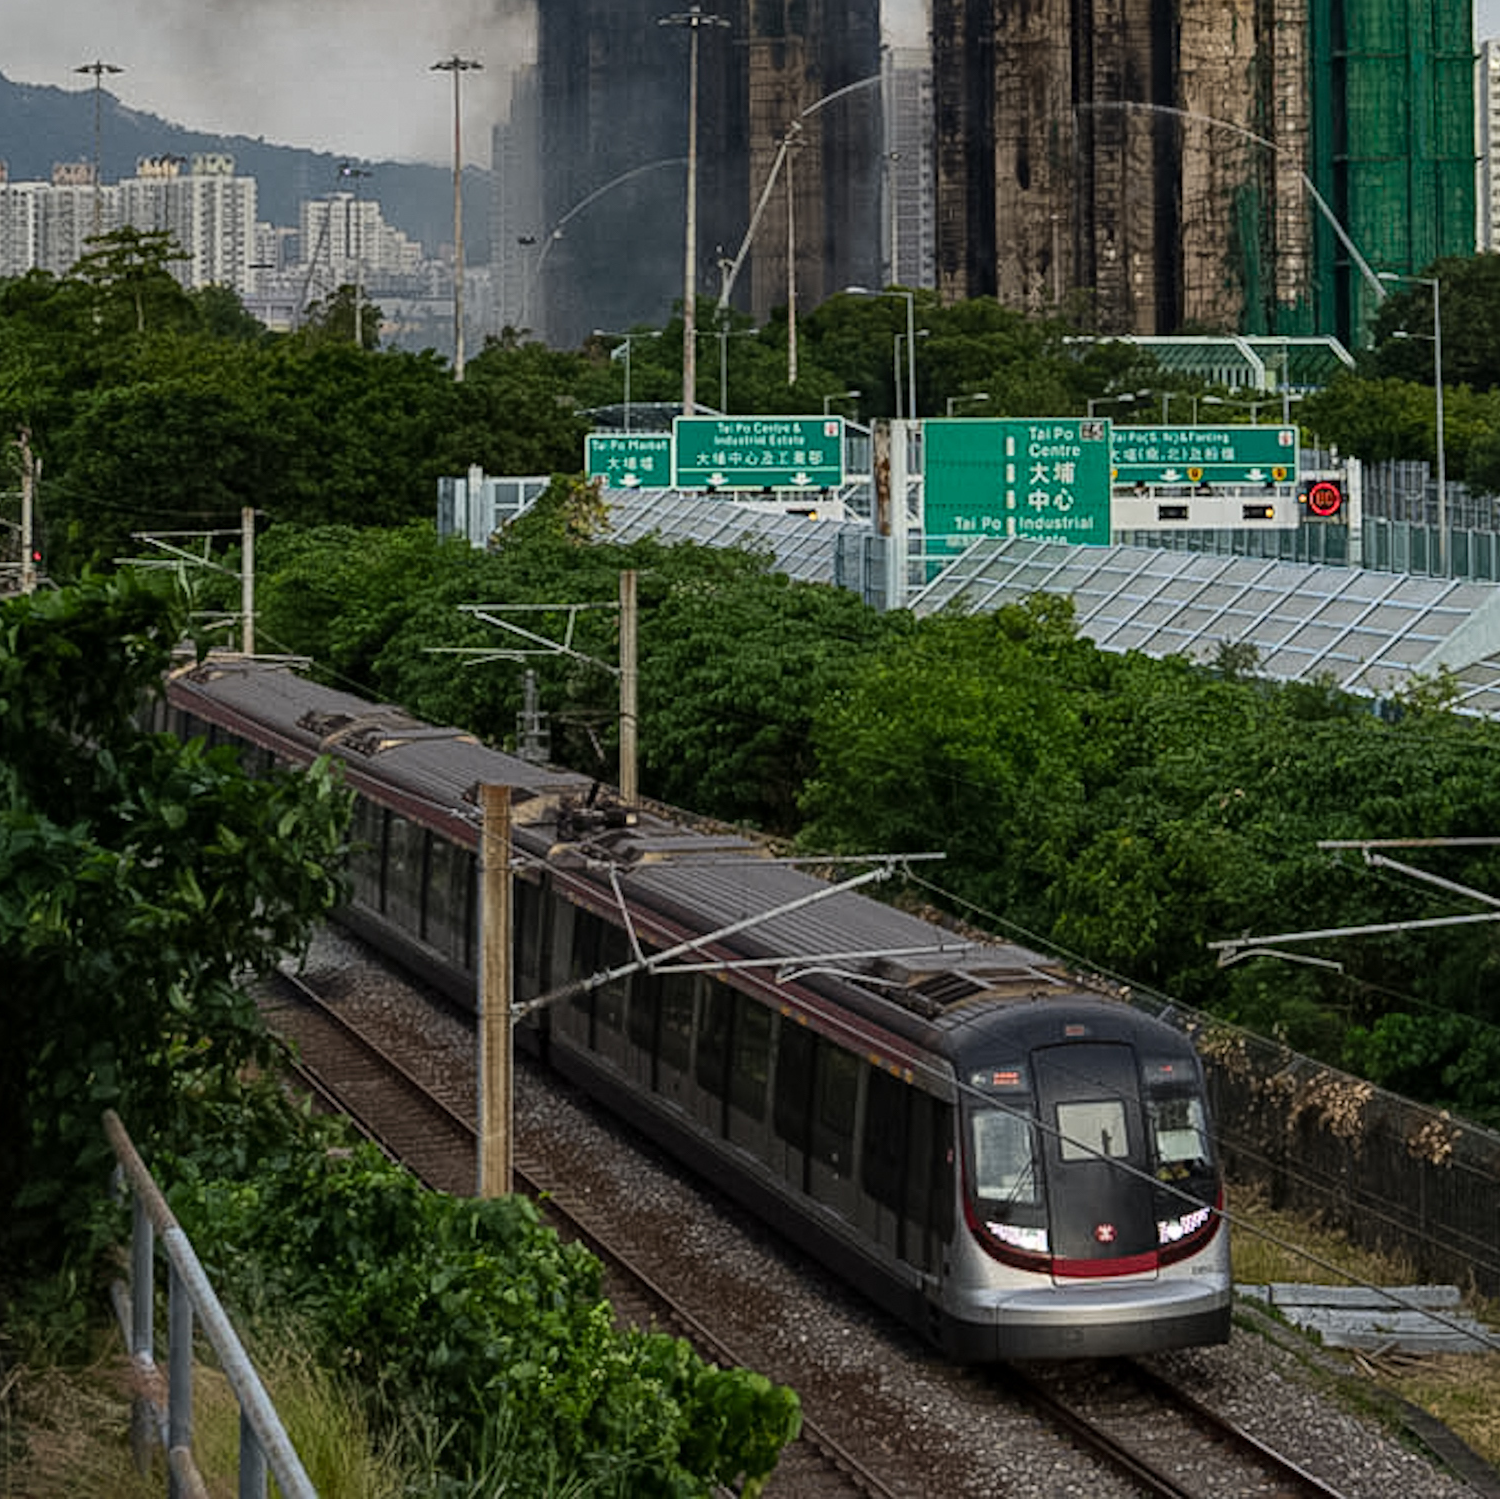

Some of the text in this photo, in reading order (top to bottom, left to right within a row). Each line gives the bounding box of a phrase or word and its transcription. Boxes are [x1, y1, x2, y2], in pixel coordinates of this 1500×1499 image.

[718, 422, 802, 434] Tai Po Centre &
[1028, 426, 1051, 441] Tai
[1053, 426, 1074, 441] Po
[591, 439, 667, 451] Tai Po Market
[714, 435, 805, 446] Industrial Estate
[1028, 443, 1081, 459] Centre
[1029, 461, 1075, 485] 大埔
[1028, 488, 1074, 512] 中心
[954, 516, 1094, 531] Tai Po Industrial
